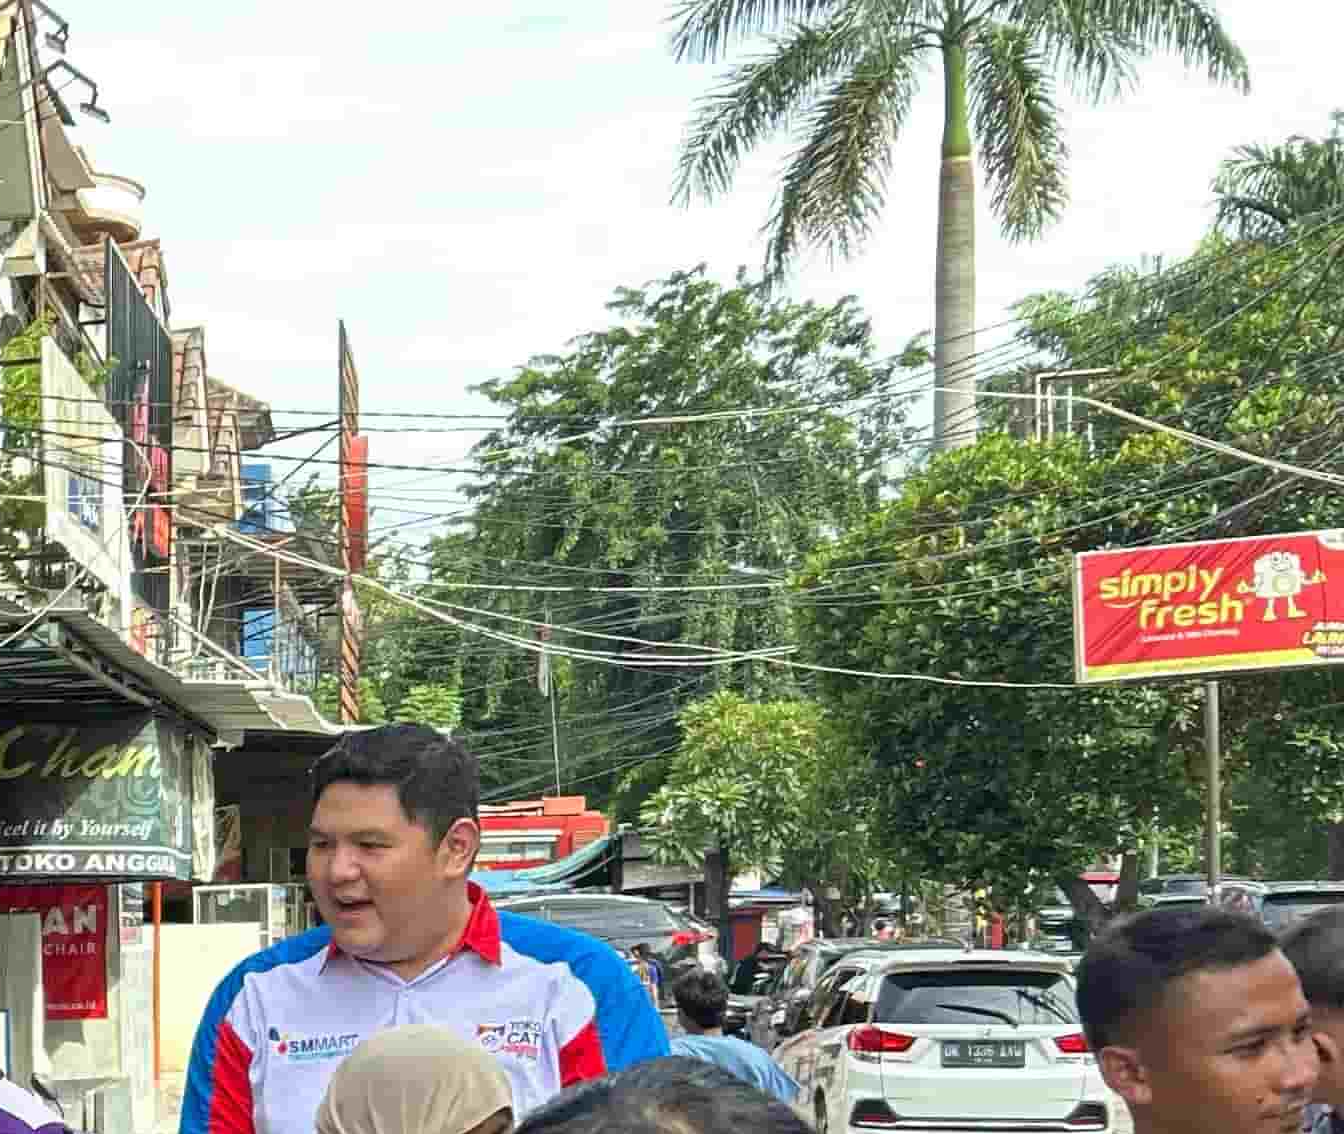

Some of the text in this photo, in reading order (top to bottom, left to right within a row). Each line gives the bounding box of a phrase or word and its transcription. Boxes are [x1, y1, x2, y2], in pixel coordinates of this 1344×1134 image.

[1099, 564, 1224, 602] simply
[1139, 594, 1244, 630] fresh
[53, 817, 74, 840] by
[43, 942, 97, 957] CHAIR
[507, 1031, 541, 1045] CAT
